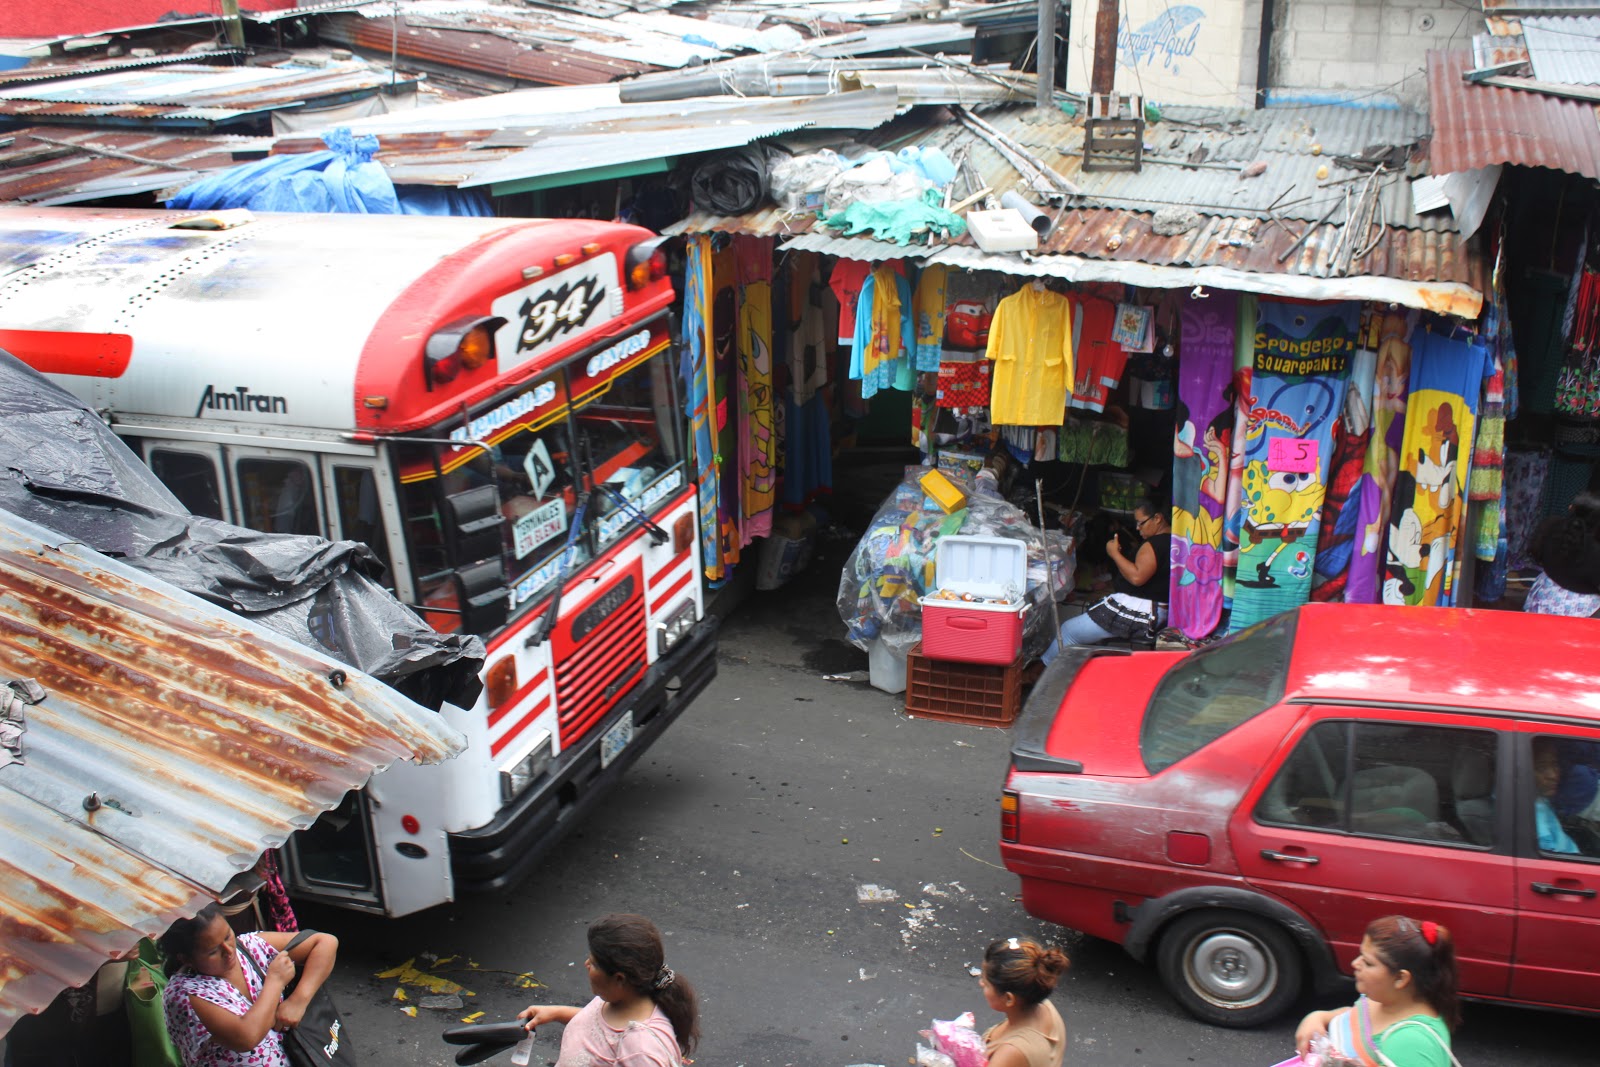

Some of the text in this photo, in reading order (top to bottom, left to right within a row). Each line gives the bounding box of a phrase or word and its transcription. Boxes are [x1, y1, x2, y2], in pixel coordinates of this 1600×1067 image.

[522, 285, 588, 344] 34
[196, 384, 288, 418] AmTran
[449, 380, 556, 452] TERMINALES
[532, 451, 549, 488] A
[1294, 443, 1310, 461] 5
